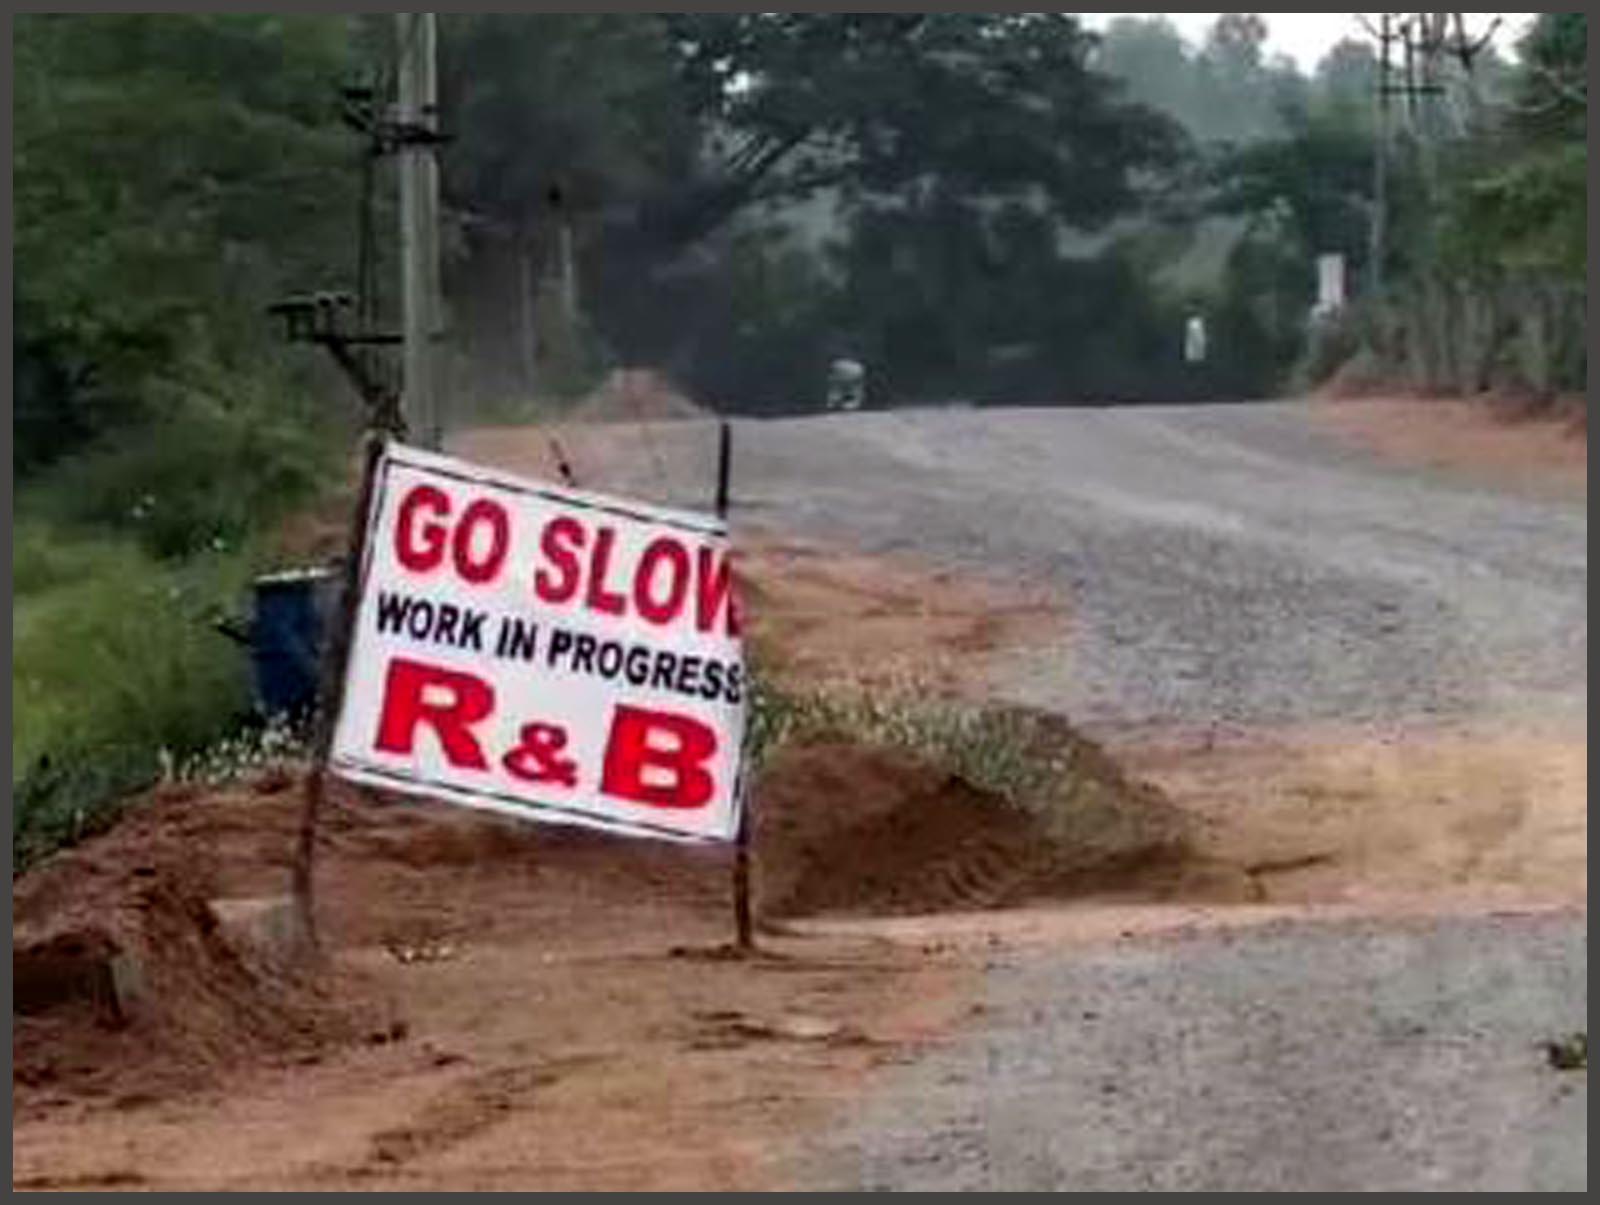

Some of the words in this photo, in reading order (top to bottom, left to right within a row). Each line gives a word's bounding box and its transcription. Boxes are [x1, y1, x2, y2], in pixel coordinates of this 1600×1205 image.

[394, 484, 510, 584] GO
[376, 590, 488, 650] WORK
[495, 617, 538, 663] IN
[547, 629, 744, 704] PROGRESS
[374, 657, 495, 771] R
[502, 722, 578, 787] &
[602, 703, 718, 809] B
